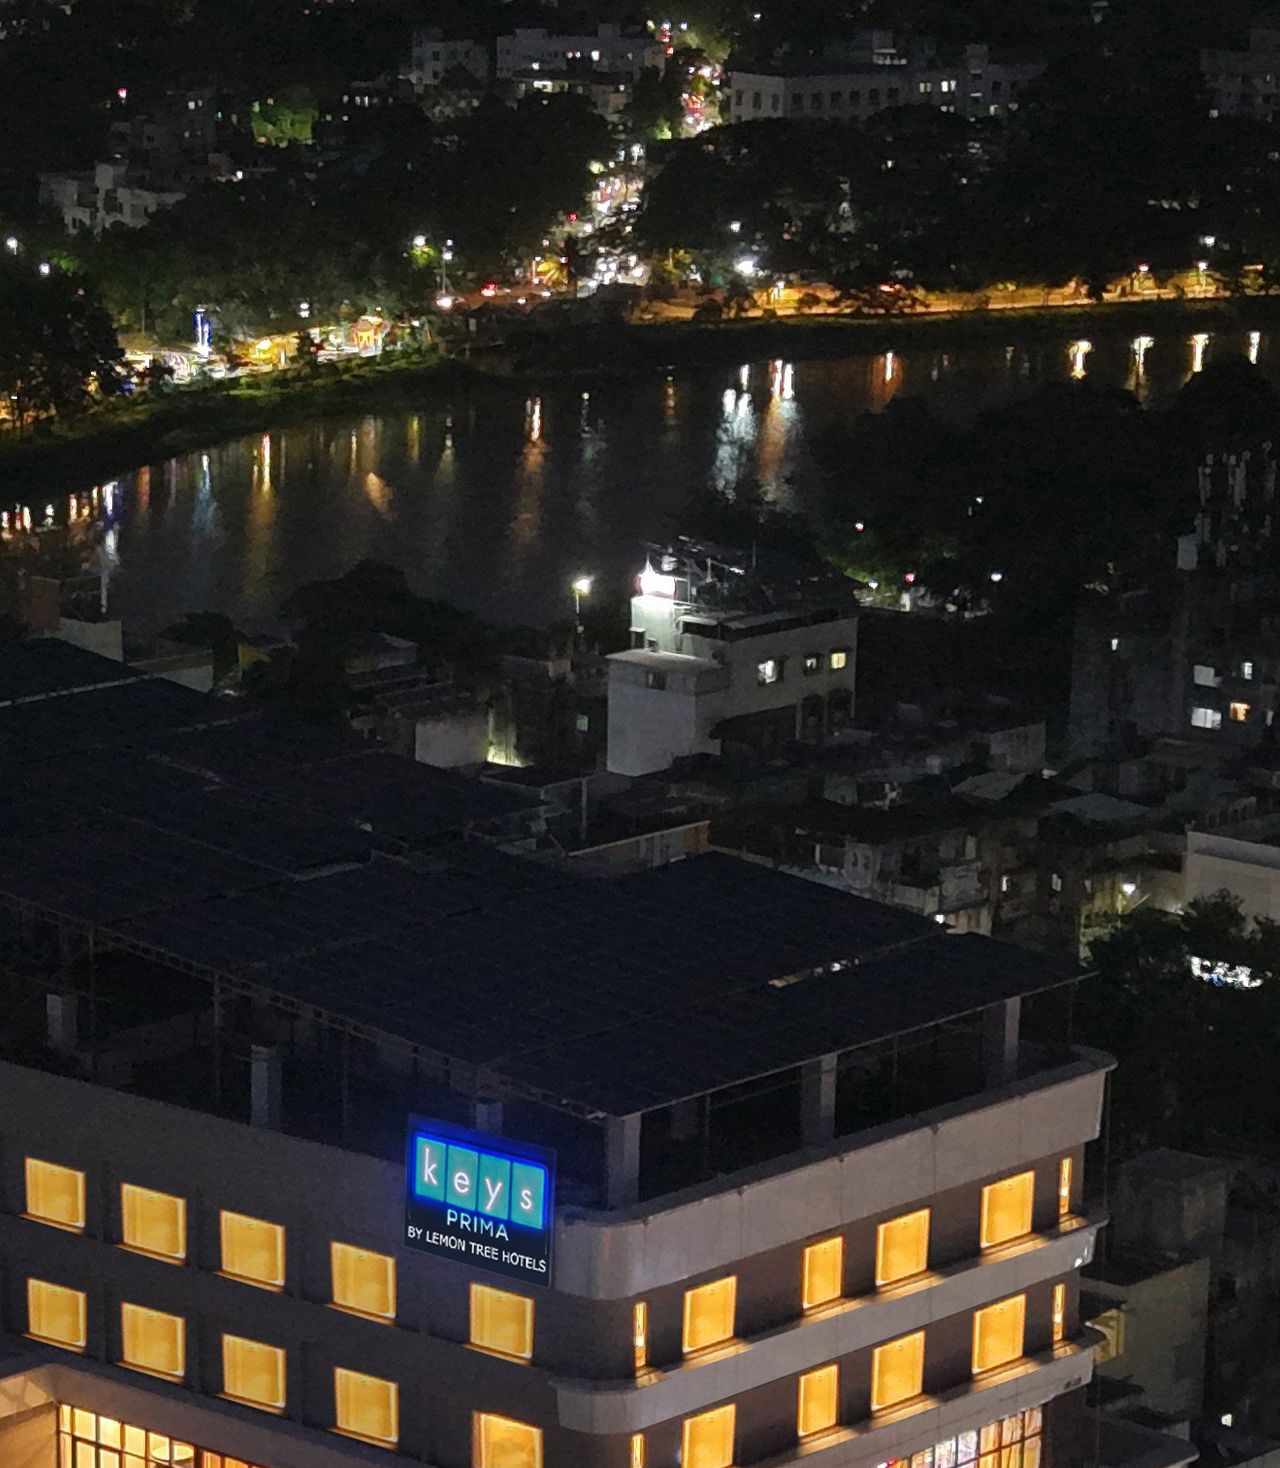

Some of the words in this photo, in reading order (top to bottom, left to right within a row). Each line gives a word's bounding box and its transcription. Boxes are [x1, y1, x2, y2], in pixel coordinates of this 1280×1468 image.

[423, 1147, 532, 1210] keys
[447, 1209, 509, 1241] PRIMA
[408, 1226, 422, 1240] BY
[426, 1230, 466, 1251] LEMON
[469, 1241, 499, 1260] TREE
[502, 1251, 547, 1273] HOTELS
